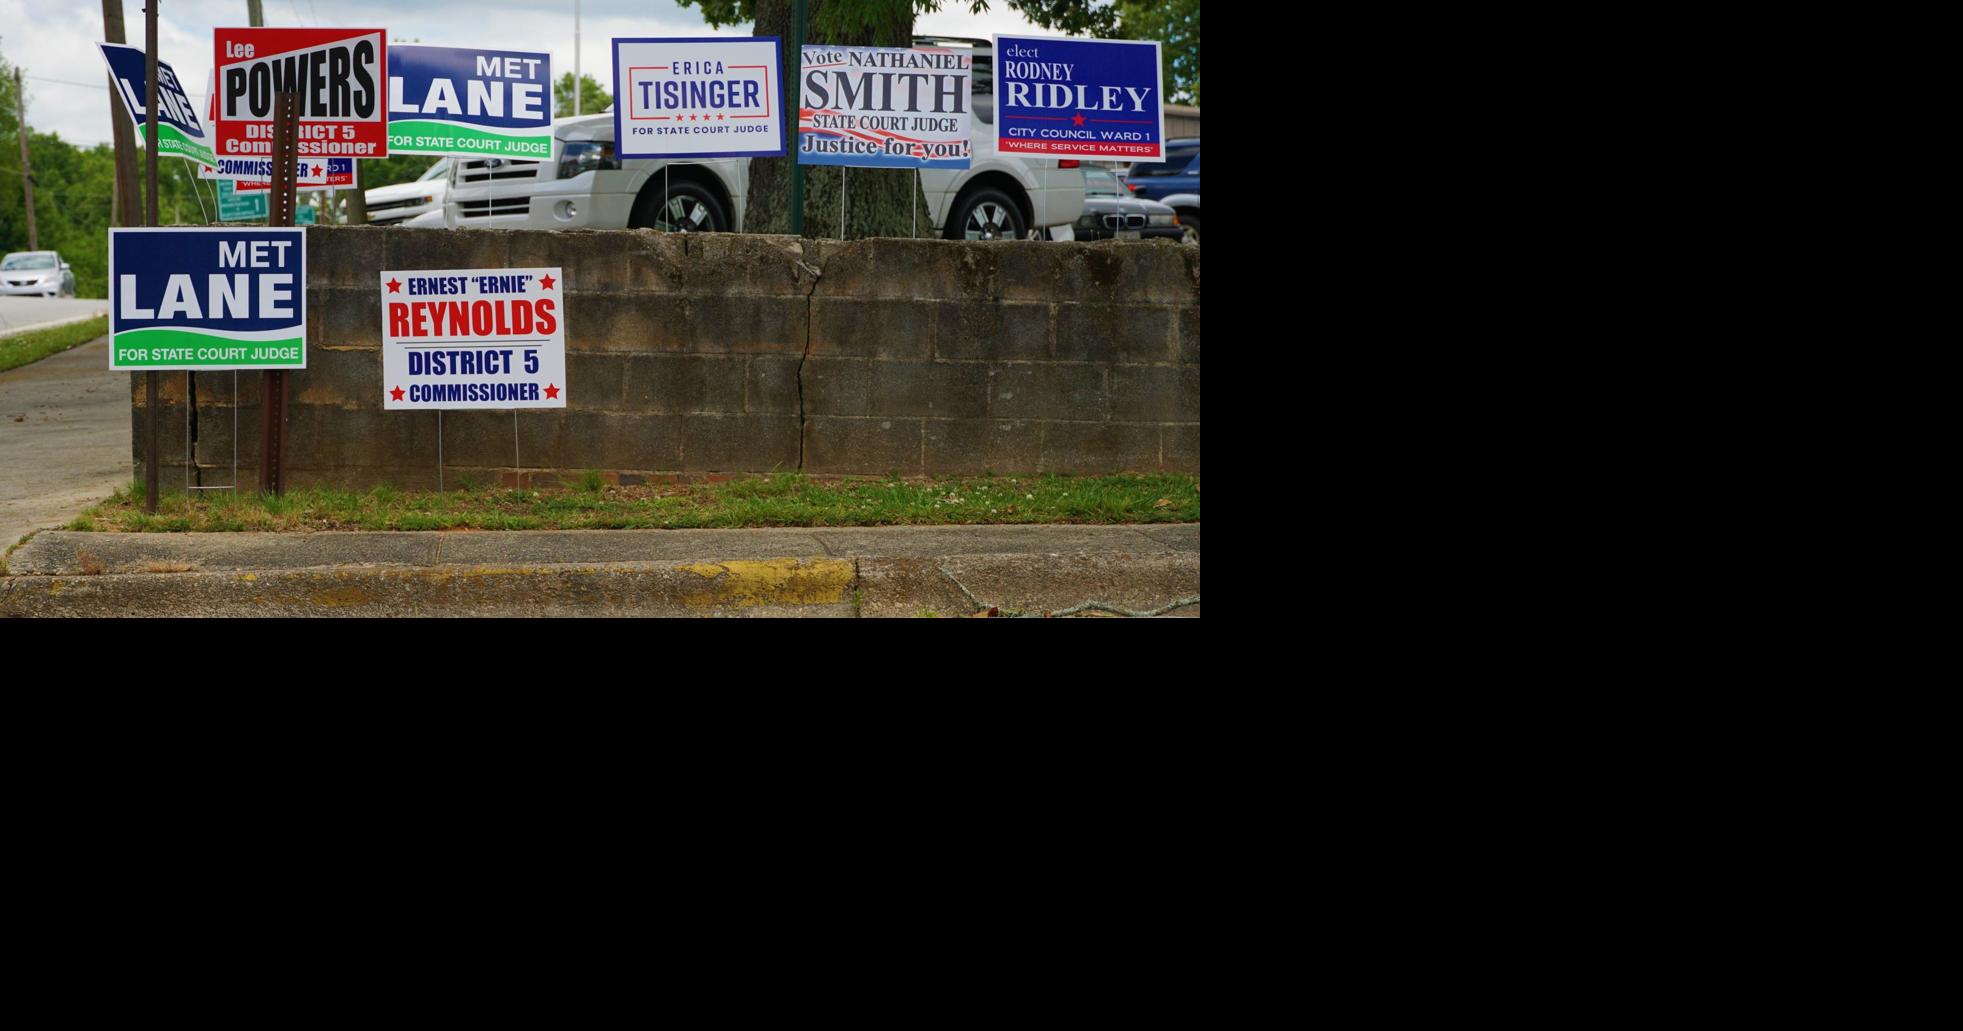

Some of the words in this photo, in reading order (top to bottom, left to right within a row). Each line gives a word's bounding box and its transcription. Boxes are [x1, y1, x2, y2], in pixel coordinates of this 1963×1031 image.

[226, 41, 255, 58] Lee
[1007, 44, 1038, 58] elect
[476, 55, 541, 79] MET
[673, 61, 724, 75] ERICA
[803, 51, 842, 65] Vote
[848, 52, 969, 70] NATHANIEL
[226, 40, 375, 118] POWERS
[1005, 61, 1074, 81] RODNEY
[389, 76, 543, 120] LANE
[638, 80, 760, 109] TISINGER
[805, 70, 967, 114] SMITH
[1005, 82, 1151, 112] RIDLEY
[246, 124, 338, 138] DISICT
[342, 125, 355, 138] 5
[694, 126, 730, 134] COURT
[733, 125, 768, 133] JUDGE
[813, 114, 856, 129] STATE
[860, 115, 908, 130] COURT
[911, 118, 958, 132] JUDGE
[1009, 127, 1036, 137] CITY
[1041, 129, 1096, 139] COUNCIL
[1100, 131, 1141, 140] WARD
[1146, 133, 1149, 141] 1
[226, 138, 376, 154] Comssioner
[388, 136, 412, 146] FOR
[416, 136, 453, 147] STATE
[457, 138, 501, 150] COURT
[504, 141, 547, 153] JUDGE
[802, 135, 877, 153] Justice
[884, 137, 916, 155] for
[918, 140, 968, 160] you!
[1051, 143, 1095, 151] SERVICE
[217, 160, 308, 177] COMMISSER
[219, 241, 292, 268] MET
[408, 277, 468, 295] ERNEST
[120, 274, 294, 320] LANE
[389, 299, 557, 337] REYNOLDS
[119, 349, 148, 360] FOR
[152, 348, 194, 360] STATE
[197, 348, 247, 360] COURT
[251, 347, 299, 359] JUDGE
[408, 350, 513, 376] DISTRICT
[524, 350, 539, 374] 5
[409, 383, 539, 402] COMMISSIONER
